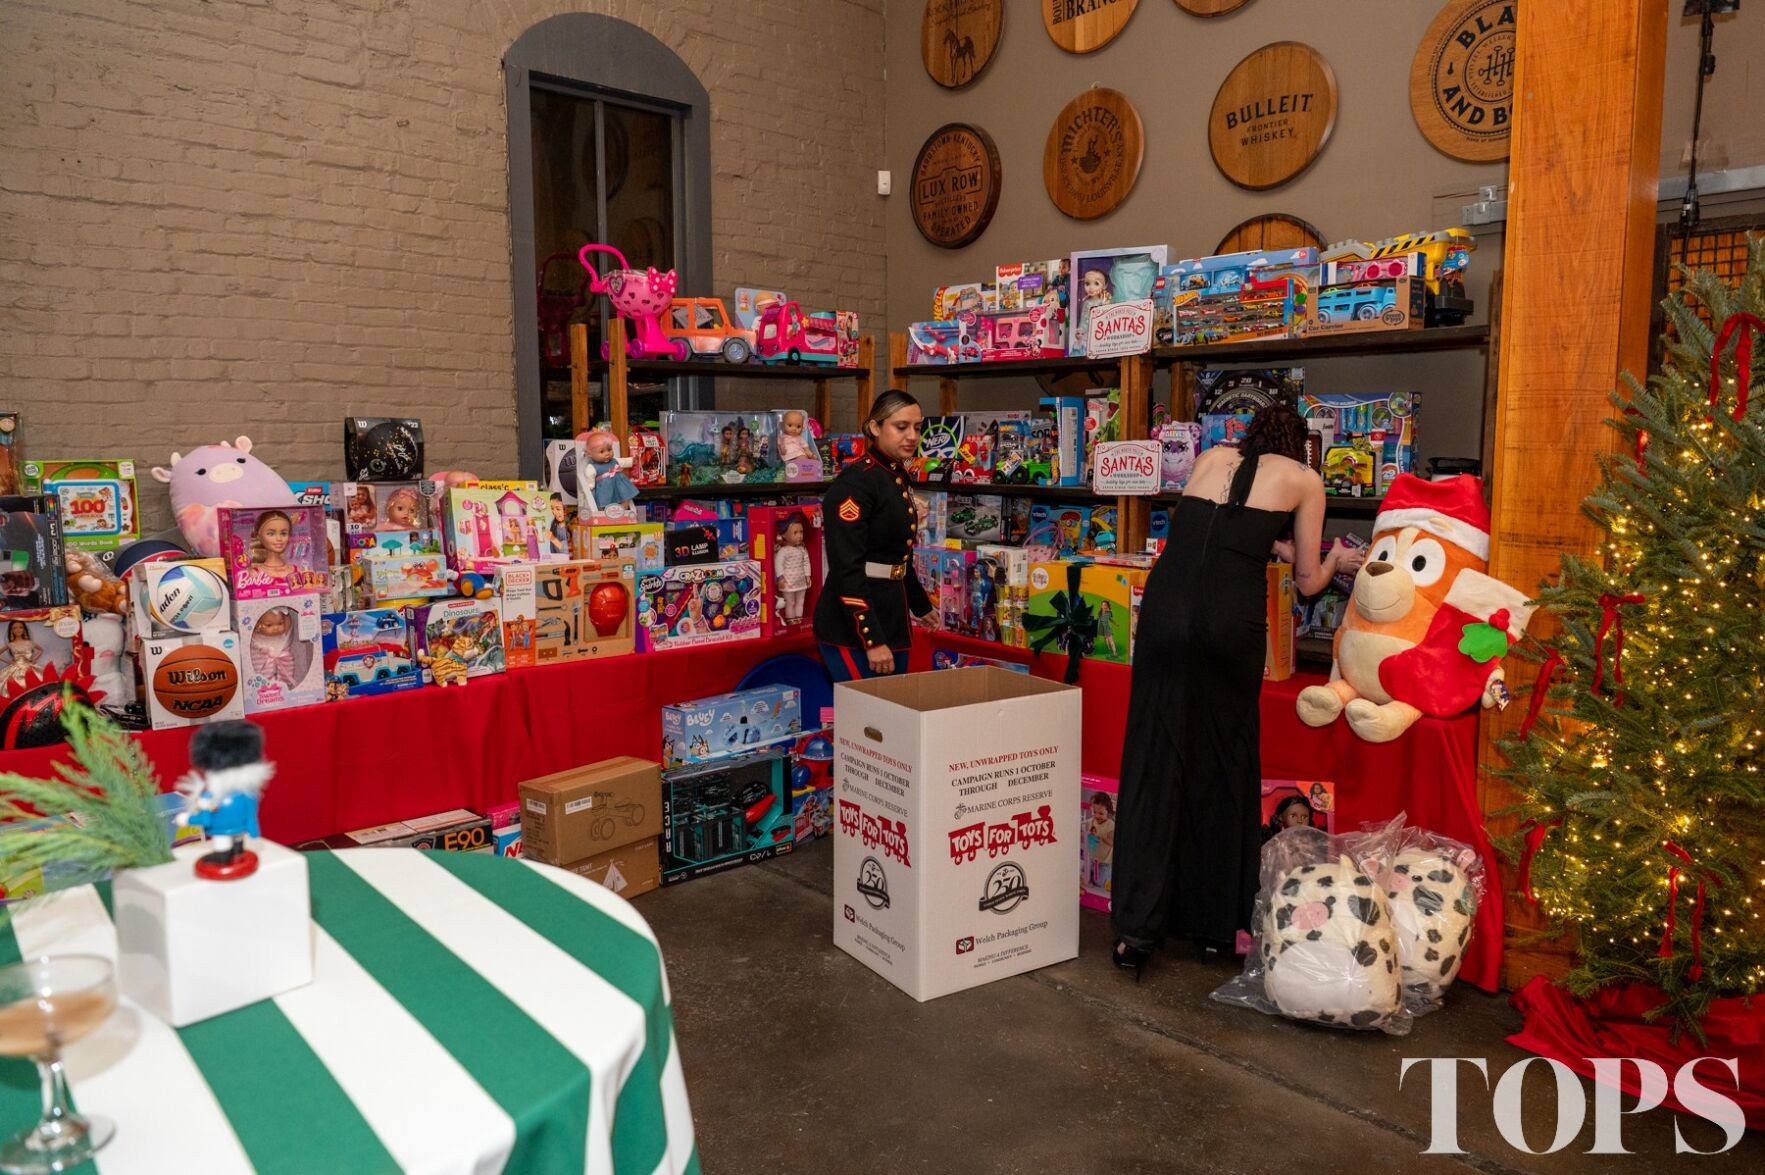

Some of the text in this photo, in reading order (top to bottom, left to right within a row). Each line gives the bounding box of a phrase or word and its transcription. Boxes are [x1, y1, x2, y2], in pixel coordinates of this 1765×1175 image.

[1053, 0, 1062, 25] BOU
[1226, 93, 1314, 129] BULLEIT
[1442, 84, 1513, 126] AND B
[1061, 106, 1122, 155] MICHTER'S
[1241, 127, 1295, 146] WHISKEY
[1247, 118, 1289, 132] FRONTIER
[953, 133, 981, 162] KENTUCKY
[922, 171, 978, 199] LUX ROW
[951, 200, 979, 216] OWNED
[1094, 315, 1145, 340] SANTA'S
[558, 443, 567, 451] W
[926, 434, 951, 448] NERF
[1100, 455, 1154, 478] SANTA'S
[70, 498, 106, 516] 100
[1032, 511, 1047, 519] vtech
[353, 536, 376, 547] DORA
[674, 543, 709, 558] 3D LAMP
[237, 571, 275, 589] Barbie
[160, 586, 182, 615] aden
[443, 607, 478, 618] Dinosaurs
[151, 646, 163, 656] W
[168, 669, 228, 685] Wilson
[172, 694, 225, 712] NCAA
[256, 694, 285, 706] Dreams
[686, 708, 716, 727] BLUEY
[840, 752, 866, 769] CAMPAIGN
[866, 763, 880, 775] RUNS
[883, 771, 910, 788] OCTOBER
[851, 743, 882, 760] UNWRAPPED
[882, 755, 897, 767] TOYS
[896, 760, 913, 773] ONLY
[949, 745, 1059, 772] NEW, UNWRAPPED TOYS ONLY
[844, 764, 905, 797] THROUGH DECEMBER
[951, 772, 994, 787] CAMPAIGN
[994, 768, 1014, 779] RUNS
[1020, 760, 1056, 773] OCTOBER
[959, 772, 1049, 797] THROUGH DECEMBER
[849, 784, 868, 799] MARINE
[885, 800, 909, 817] RESERVE
[967, 789, 1053, 814] MARINE CORPS RESERVE
[444, 827, 485, 852] E90
[841, 806, 906, 856] TOYS FOR TOTS
[951, 820, 1050, 852] TOYS FOR TOTS
[992, 874, 1022, 897] 250
[868, 921, 892, 944] Packaging
[891, 934, 906, 952] Group
[975, 920, 1048, 945] Welch Packaging Group
[1000, 944, 1029, 957] DIFFERENCE
